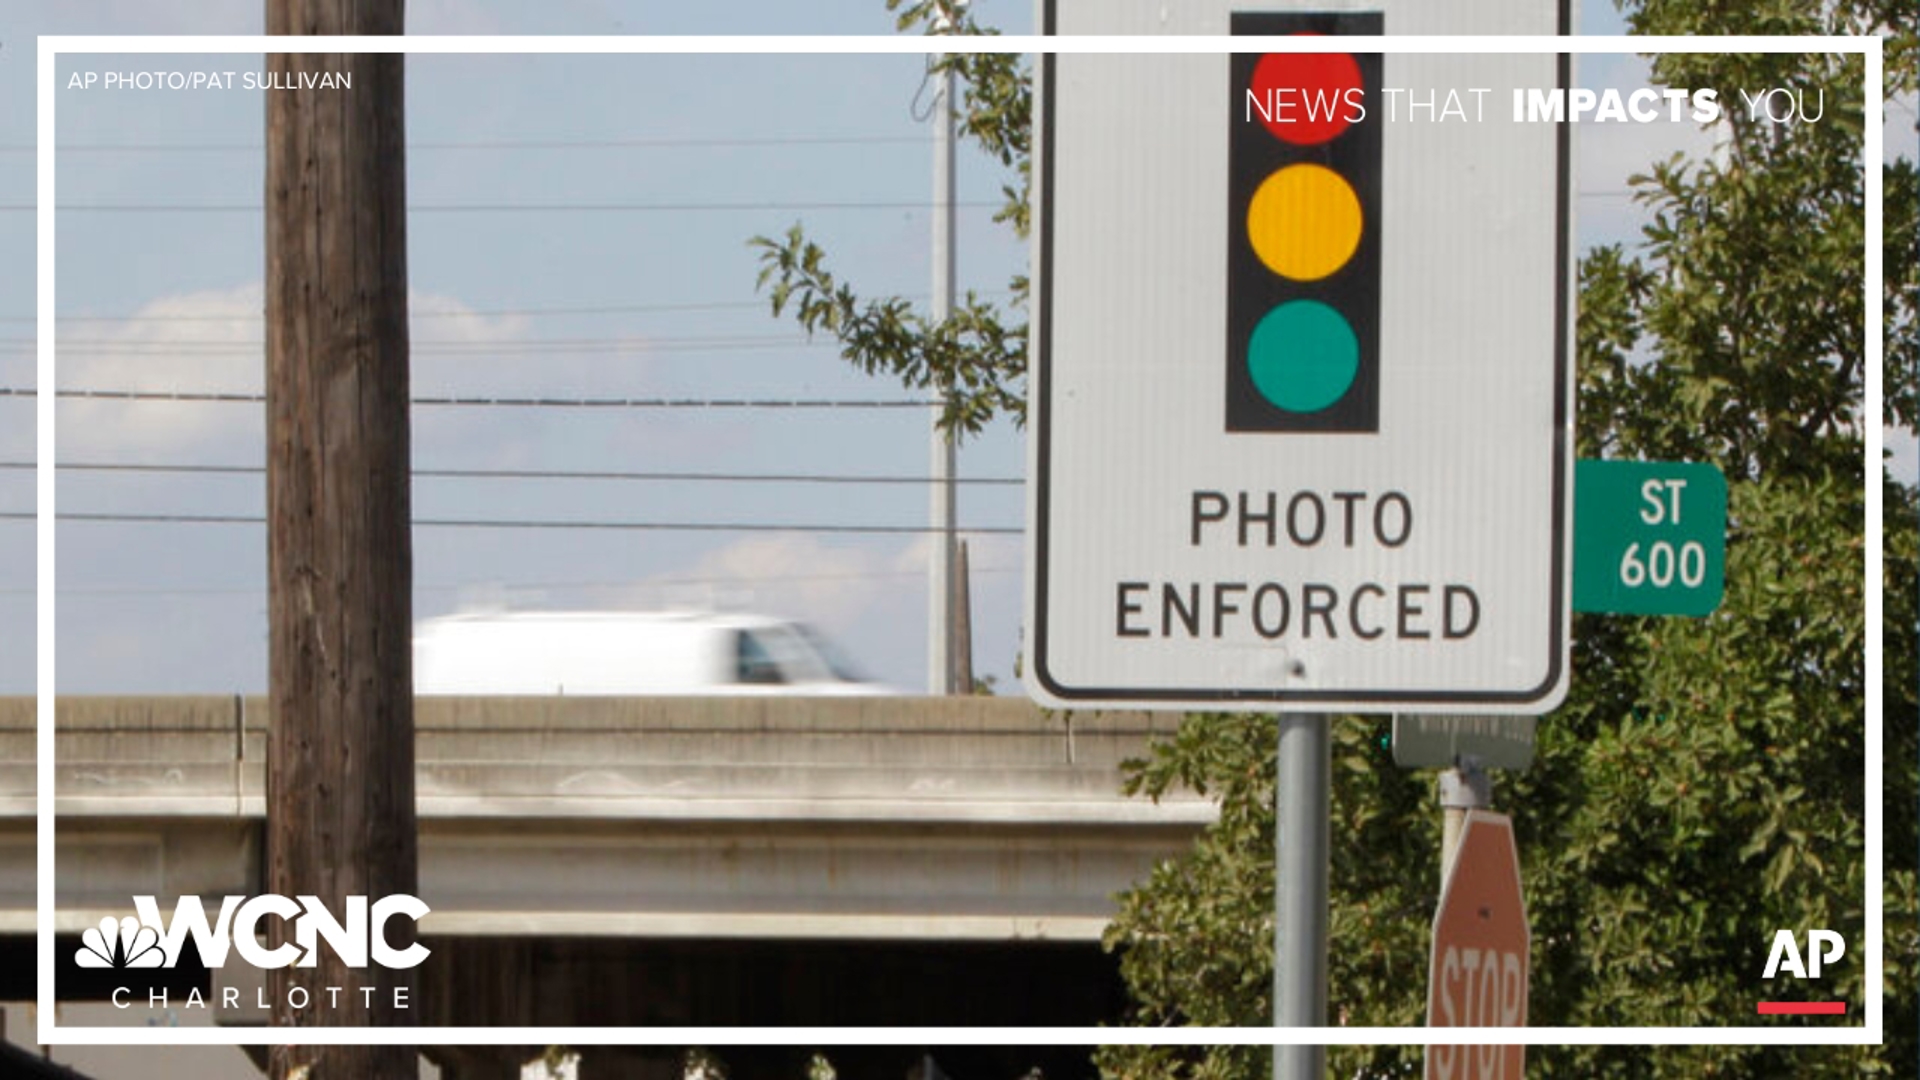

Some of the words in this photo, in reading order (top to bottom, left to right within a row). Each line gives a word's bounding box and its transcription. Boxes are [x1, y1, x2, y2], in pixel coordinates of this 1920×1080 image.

[1190, 490, 1413, 548] PHOTO
[1640, 478, 1687, 525] ST
[1618, 541, 1706, 588] 600
[1115, 581, 1482, 641] ENFORCED
[1435, 944, 1521, 1080] STOP
